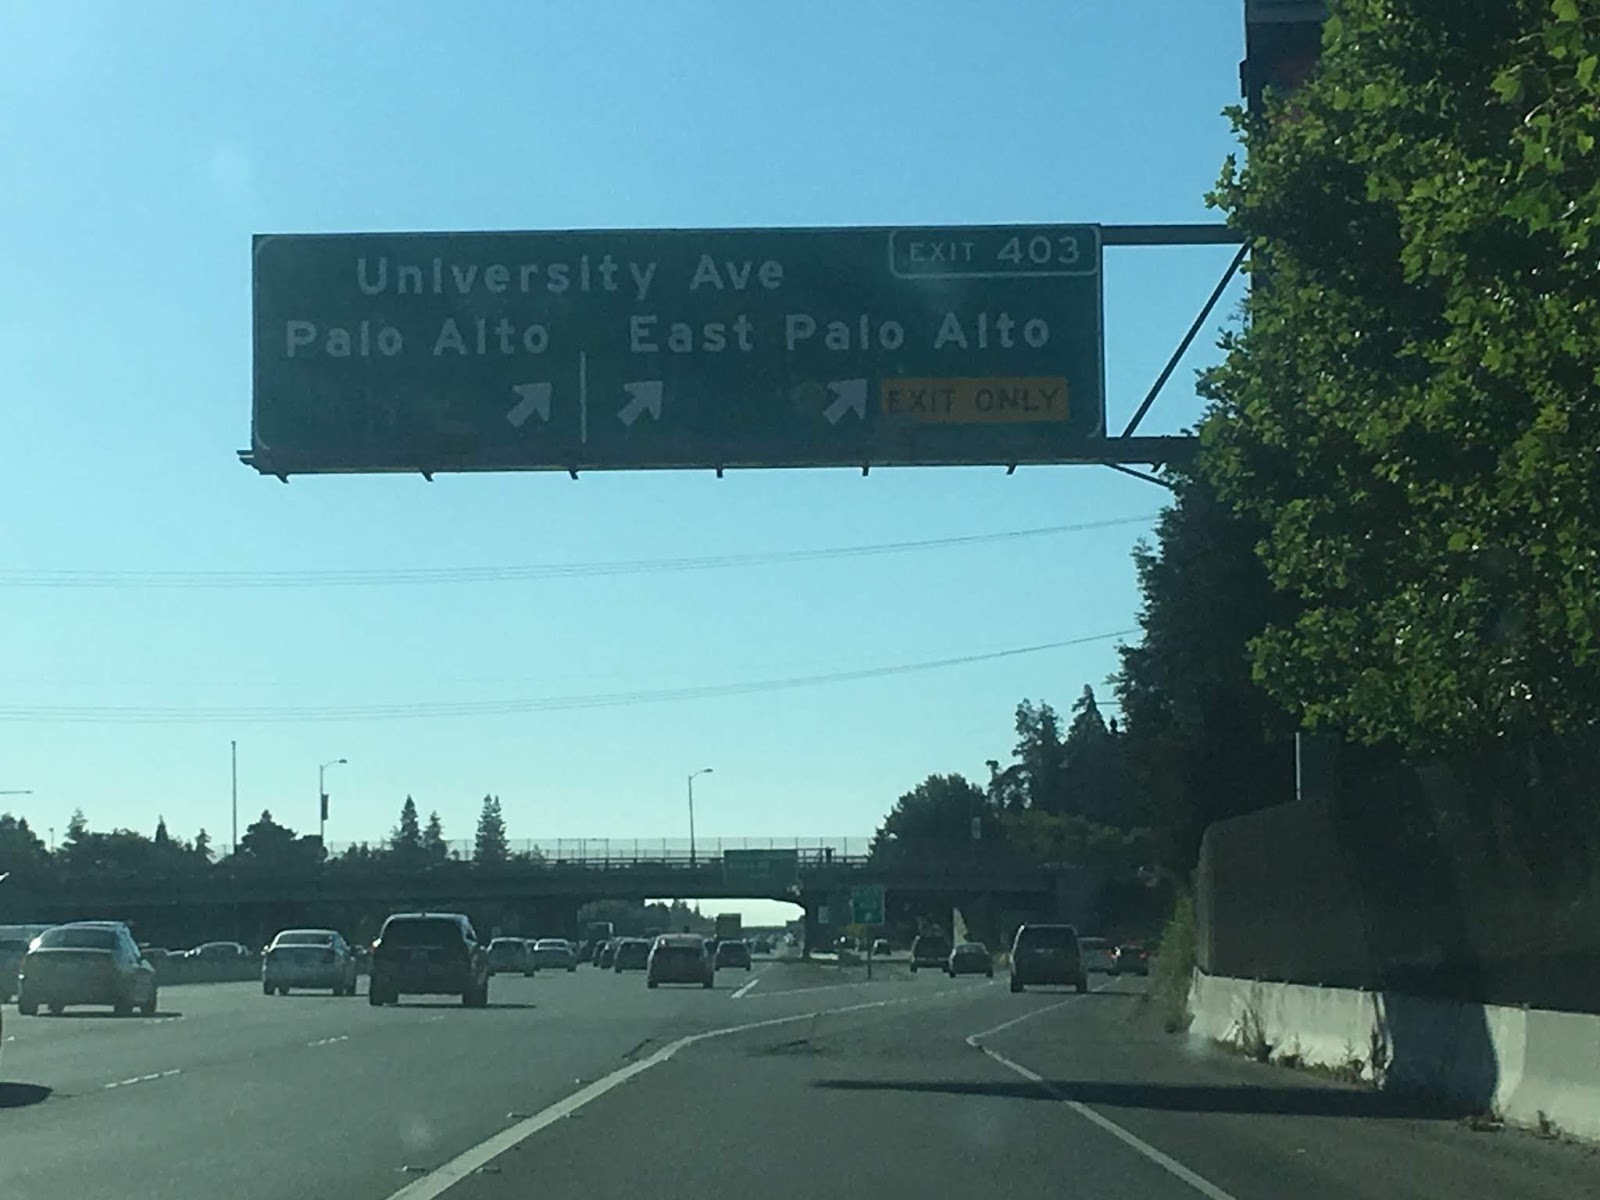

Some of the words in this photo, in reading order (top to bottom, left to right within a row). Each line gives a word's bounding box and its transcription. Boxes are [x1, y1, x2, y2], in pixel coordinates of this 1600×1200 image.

[909, 242, 974, 263] EXIT
[997, 236, 1080, 264] 403
[356, 254, 657, 300] University
[689, 254, 784, 290] Ave
[286, 319, 404, 358] Palo
[433, 317, 550, 356] Alto
[629, 314, 753, 353] East
[785, 313, 904, 352] Palo
[933, 312, 1051, 350] Alto
[888, 388, 957, 414] EXIT
[975, 387, 1061, 413] ONLY
